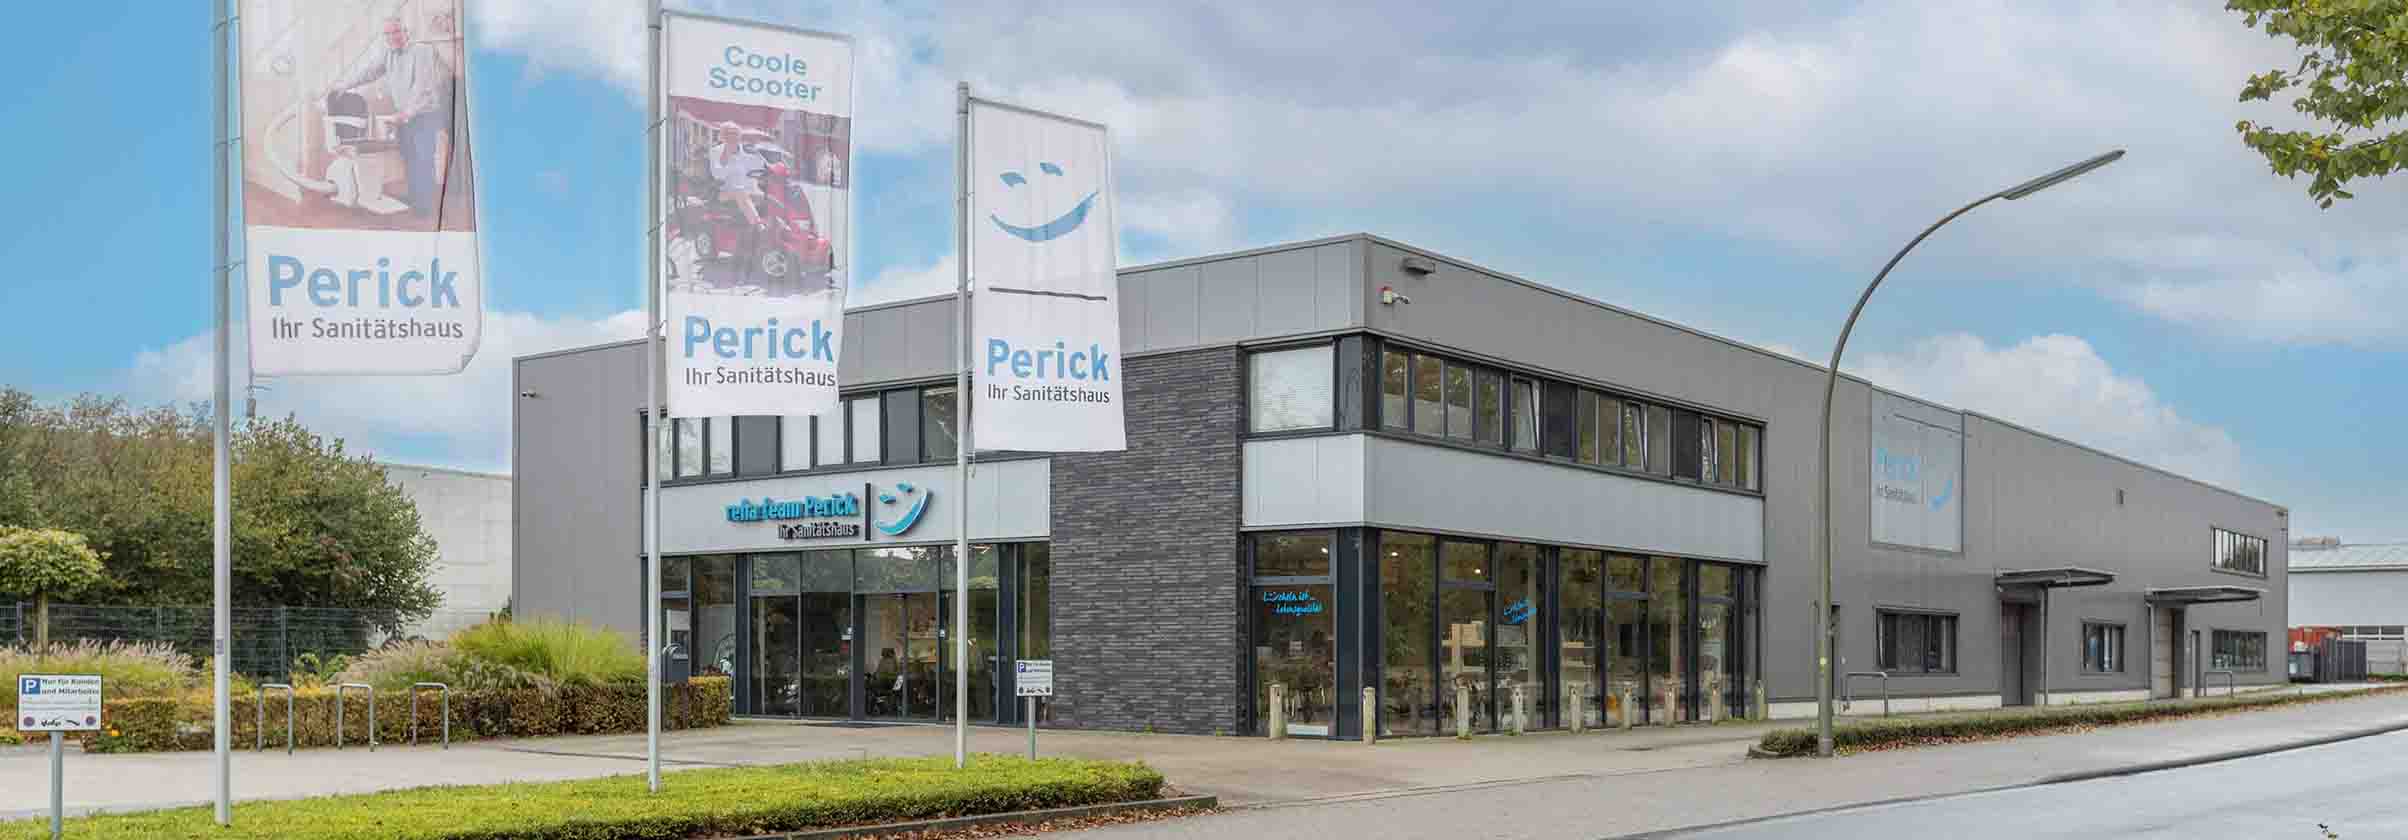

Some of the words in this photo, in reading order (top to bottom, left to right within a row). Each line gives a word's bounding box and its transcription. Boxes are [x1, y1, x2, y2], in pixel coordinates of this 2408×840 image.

[724, 46, 806, 75] Coole
[709, 67, 823, 101] Scooter
[269, 255, 458, 307] Perick
[272, 317, 303, 338] Ihr
[312, 318, 463, 338] Sanitätshaus
[685, 315, 833, 361] Perick
[987, 338, 1109, 381] Perick
[686, 367, 711, 384] Ihr
[716, 367, 835, 386] Sanitätshaus
[987, 384, 1007, 400] Ihr
[1013, 385, 1110, 403] Sanitätshaus
[805, 493, 857, 517] Perick
